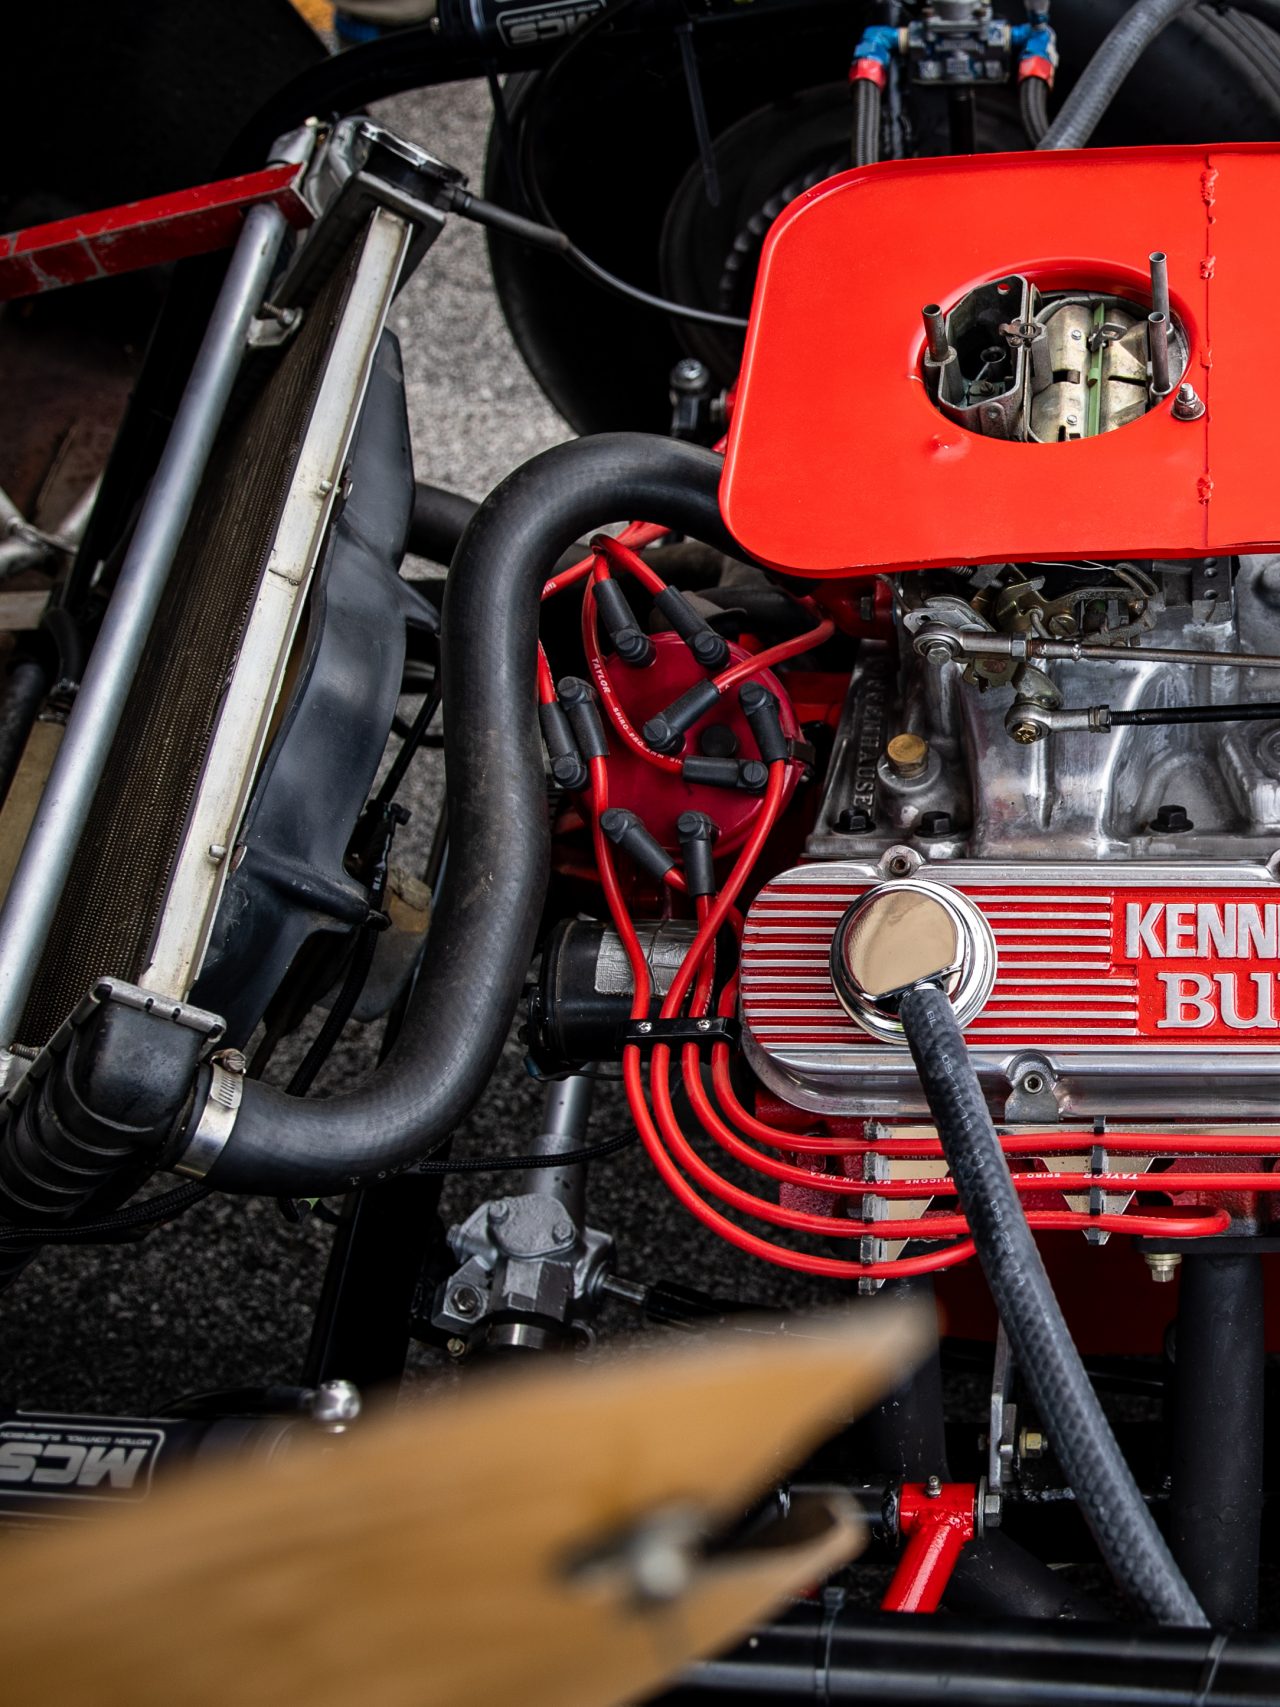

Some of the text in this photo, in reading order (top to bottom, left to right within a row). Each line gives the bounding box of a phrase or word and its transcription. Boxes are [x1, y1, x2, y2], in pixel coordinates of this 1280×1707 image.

[591, 657, 611, 694] TAYLOR
[843, 1174, 854, 1183] IN
[905, 1176, 954, 1185] ILICONE
[1082, 1172, 1139, 1180] TAYLOR
[66, 1435, 112, 1444] CONTROL
[114, 1437, 153, 1446] MOTION
[0, 1442, 148, 1488] MCS
